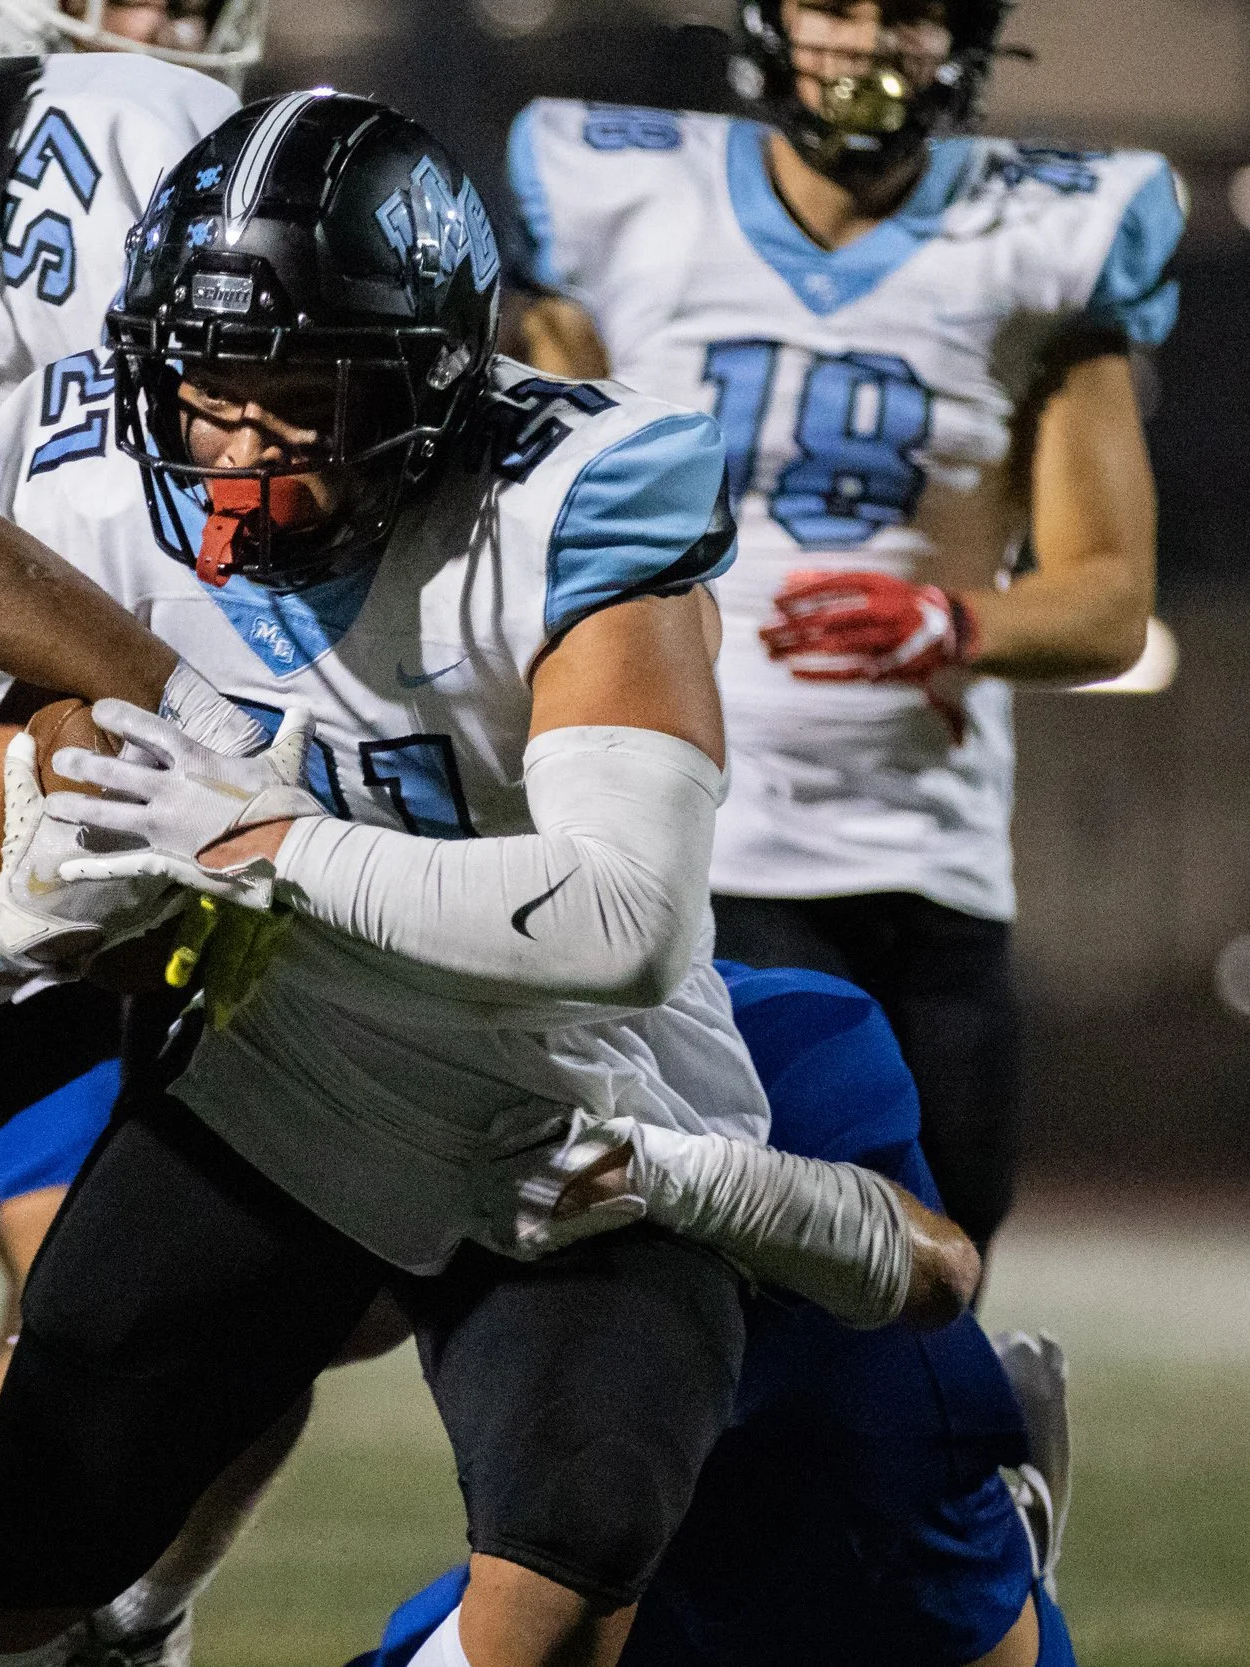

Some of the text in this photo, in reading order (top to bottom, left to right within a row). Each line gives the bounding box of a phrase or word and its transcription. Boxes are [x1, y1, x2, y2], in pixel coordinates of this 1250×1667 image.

[0, 106, 102, 307] 57
[700, 338, 931, 553] 18
[217, 692, 482, 839] 1
